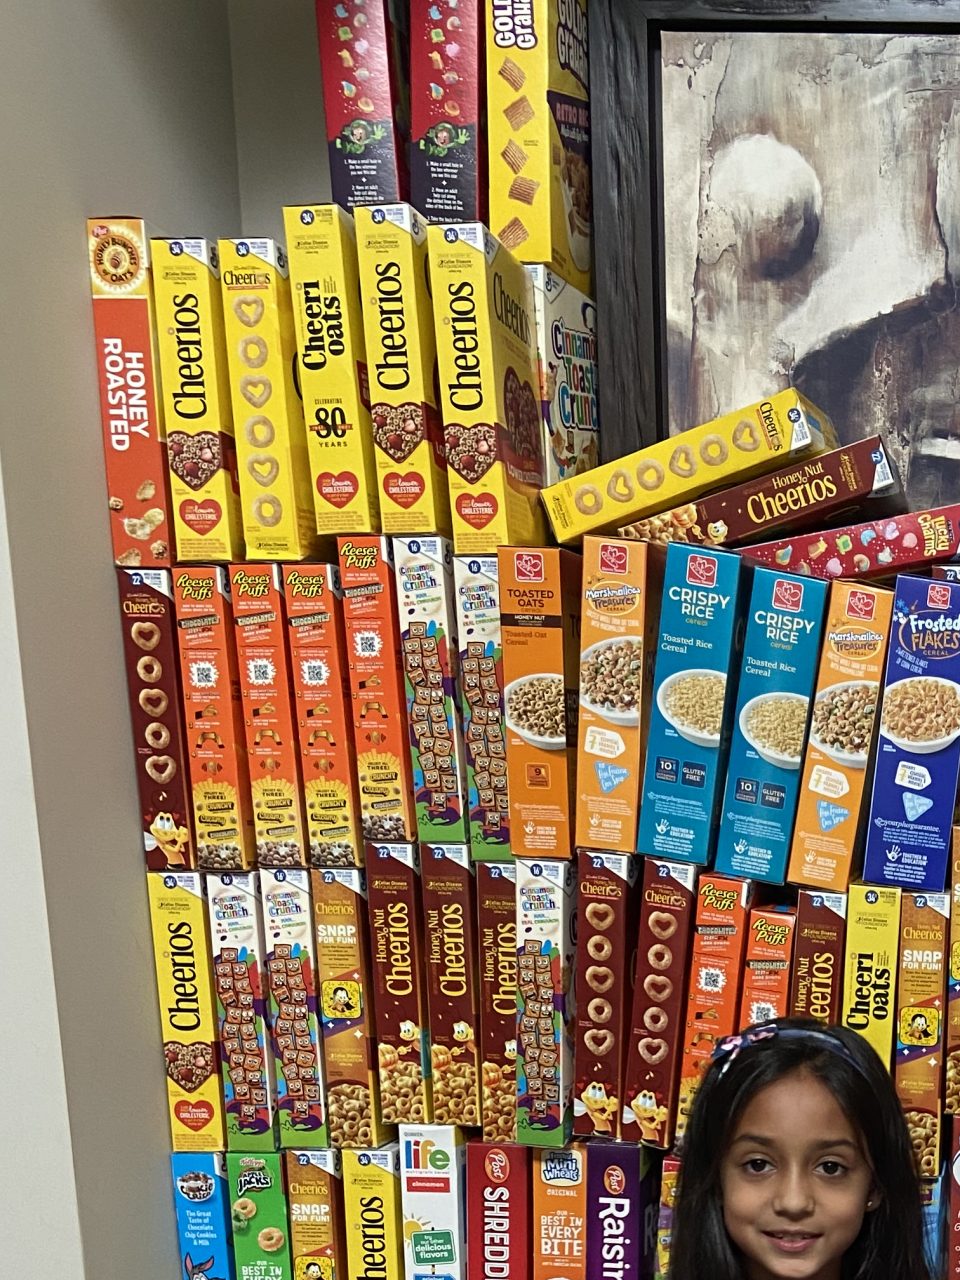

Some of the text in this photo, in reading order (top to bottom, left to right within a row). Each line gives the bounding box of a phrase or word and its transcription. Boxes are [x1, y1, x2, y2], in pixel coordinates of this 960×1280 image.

[326, 296, 345, 357] oats
[448, 281, 482, 412] Cheerios
[171, 293, 207, 419] Cheerios
[103, 338, 130, 450] ROASTED
[124, 351, 149, 437] HONEY
[315, 407, 345, 439] 80
[772, 463, 825, 490] Honey Nut
[747, 475, 836, 524] Cheerios
[340, 543, 378, 558] Reese's
[345, 554, 377, 569] Puffs
[584, 587, 640, 600] Marshmallow
[668, 587, 731, 609] CRISPY
[591, 597, 639, 609] Treasures
[681, 603, 714, 619] RICE
[661, 643, 687, 654] Cereal
[662, 634, 713, 649] Toasted Rice
[911, 631, 960, 650] FLAKES
[683, 767, 705, 776] GLUTEN
[317, 925, 356, 938] SNAP
[318, 936, 356, 944] FOR FUN!
[169, 921, 201, 1032] Cheerios
[405, 1140, 450, 1169] life
[541, 1216, 582, 1226] BEST IN
[541, 1225, 582, 1239] EVERY
[415, 1243, 452, 1251] delicious
[541, 1239, 582, 1256] BITE
